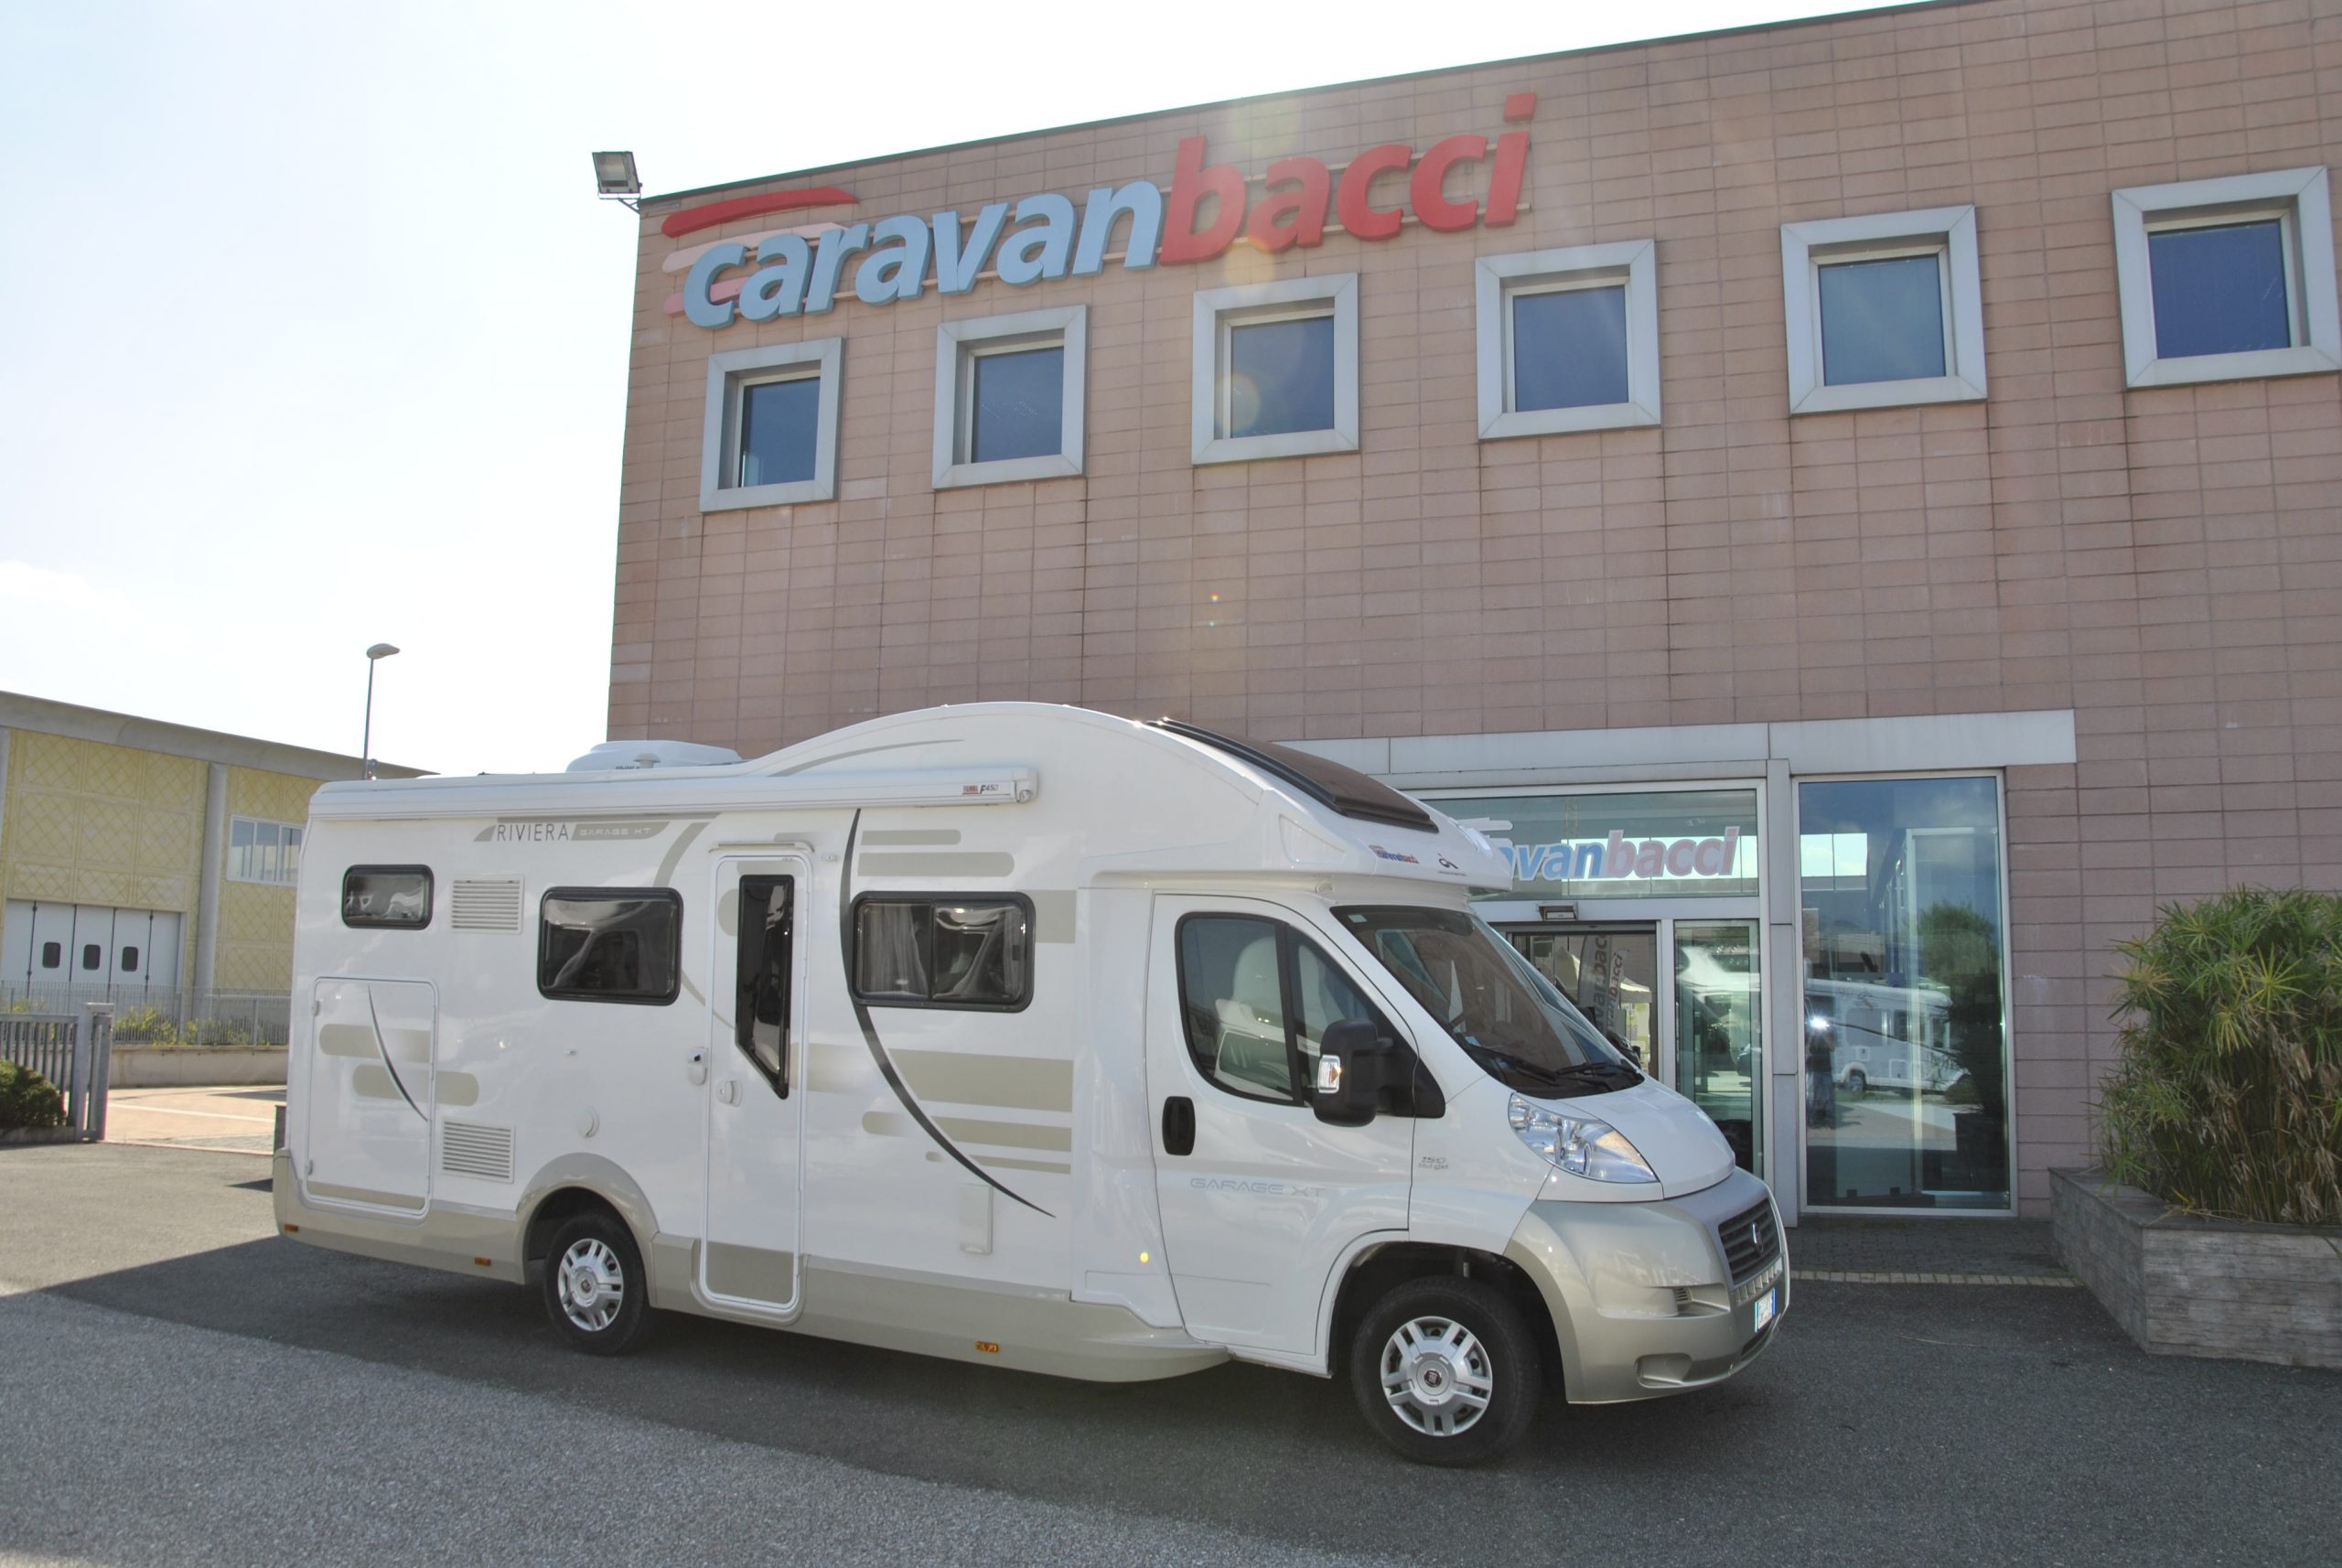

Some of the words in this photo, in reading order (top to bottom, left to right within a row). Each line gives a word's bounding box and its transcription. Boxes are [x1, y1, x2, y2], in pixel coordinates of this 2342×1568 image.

[497, 824, 569, 841] RIVIERA
[1190, 1177, 1284, 1195] GARAGE
[1292, 1186, 1326, 1197] XT
